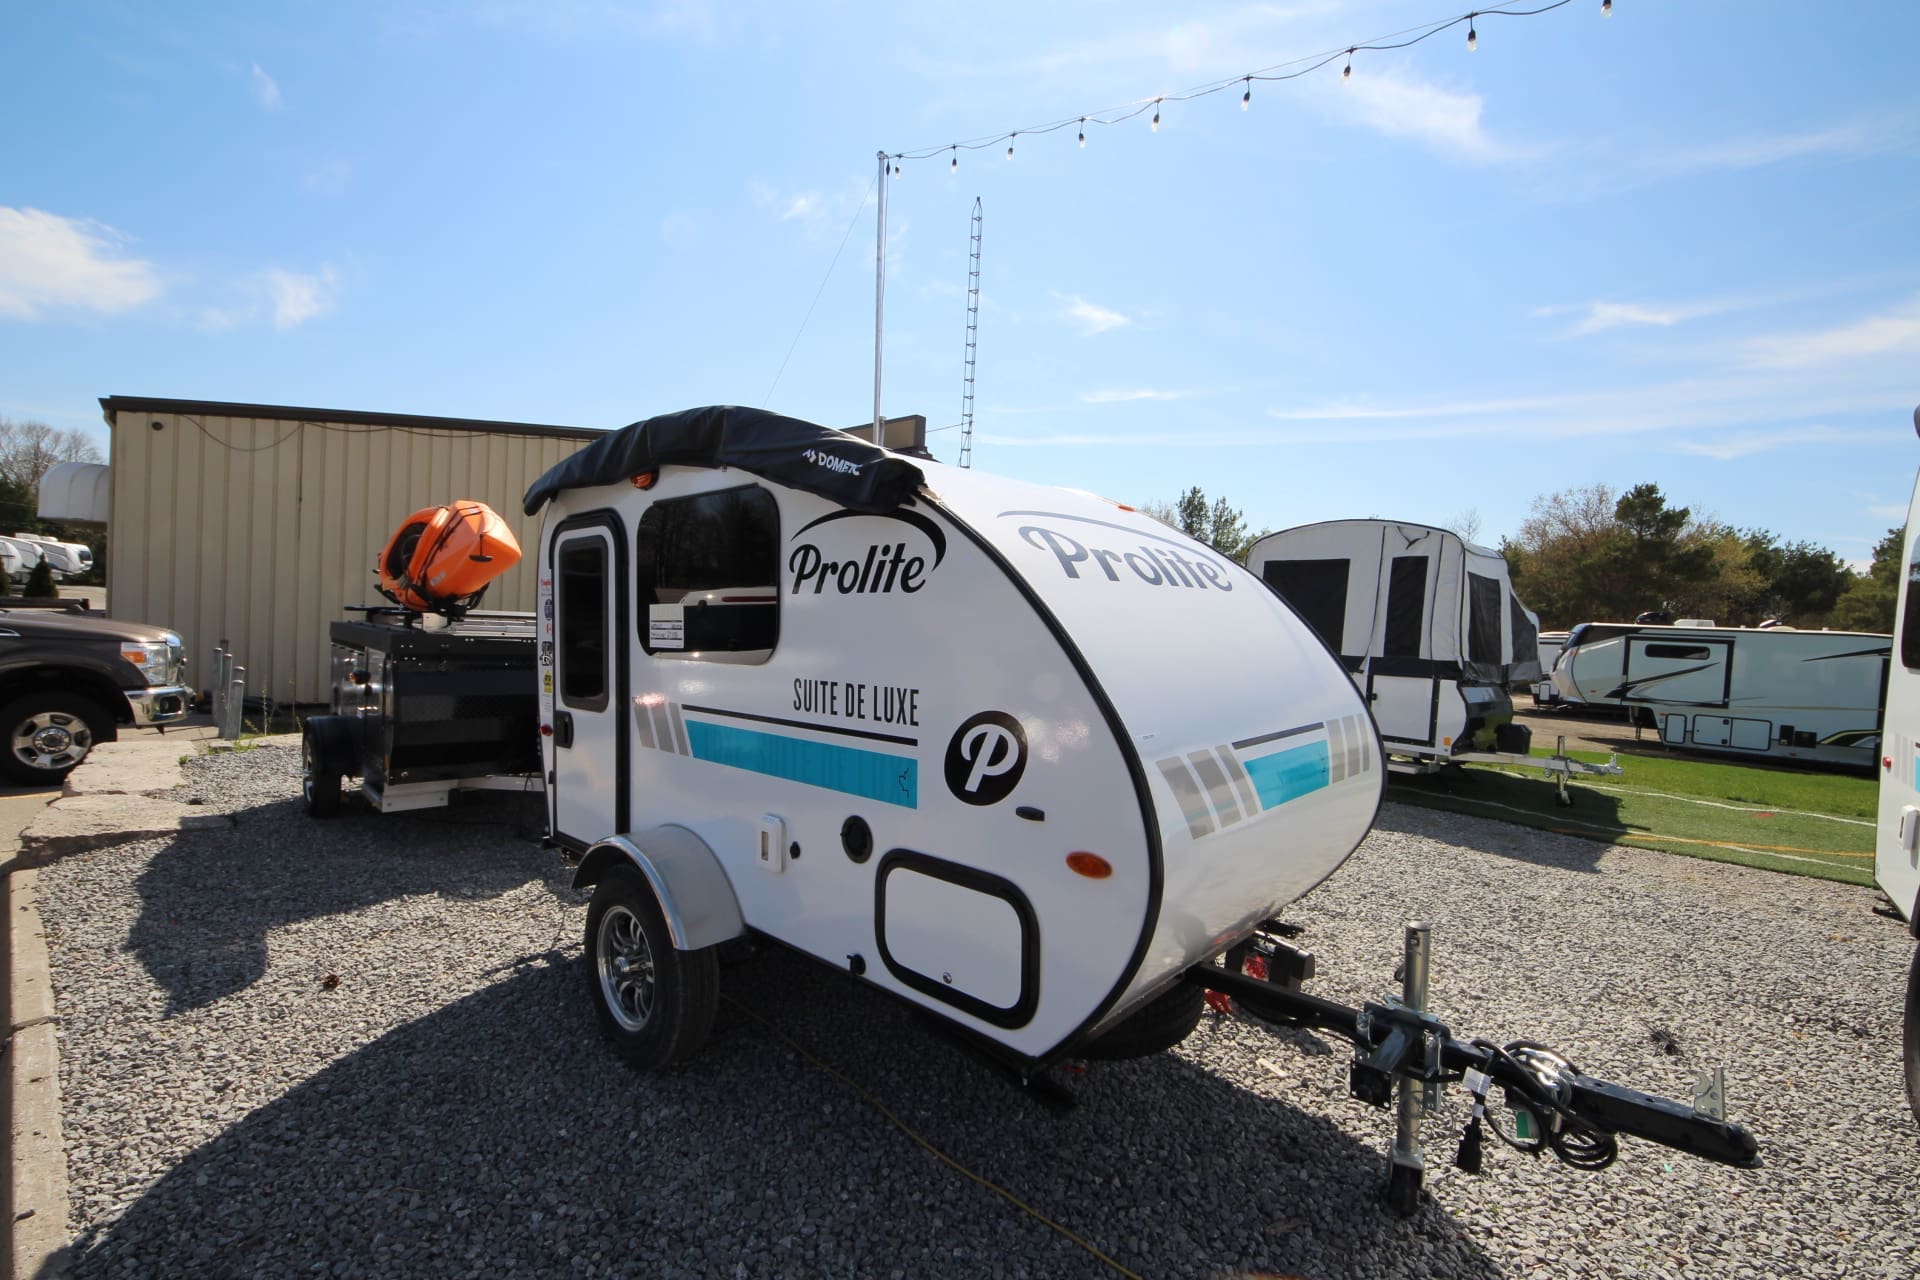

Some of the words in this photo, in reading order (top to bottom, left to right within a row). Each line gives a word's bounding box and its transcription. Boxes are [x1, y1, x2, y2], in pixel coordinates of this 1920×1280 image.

[789, 543, 927, 594] Prolite
[1018, 526, 1233, 592] Prolite
[793, 678, 839, 716] SUITE
[845, 683, 866, 720] DE
[873, 685, 919, 727] LUXE
[960, 723, 1020, 793] P
